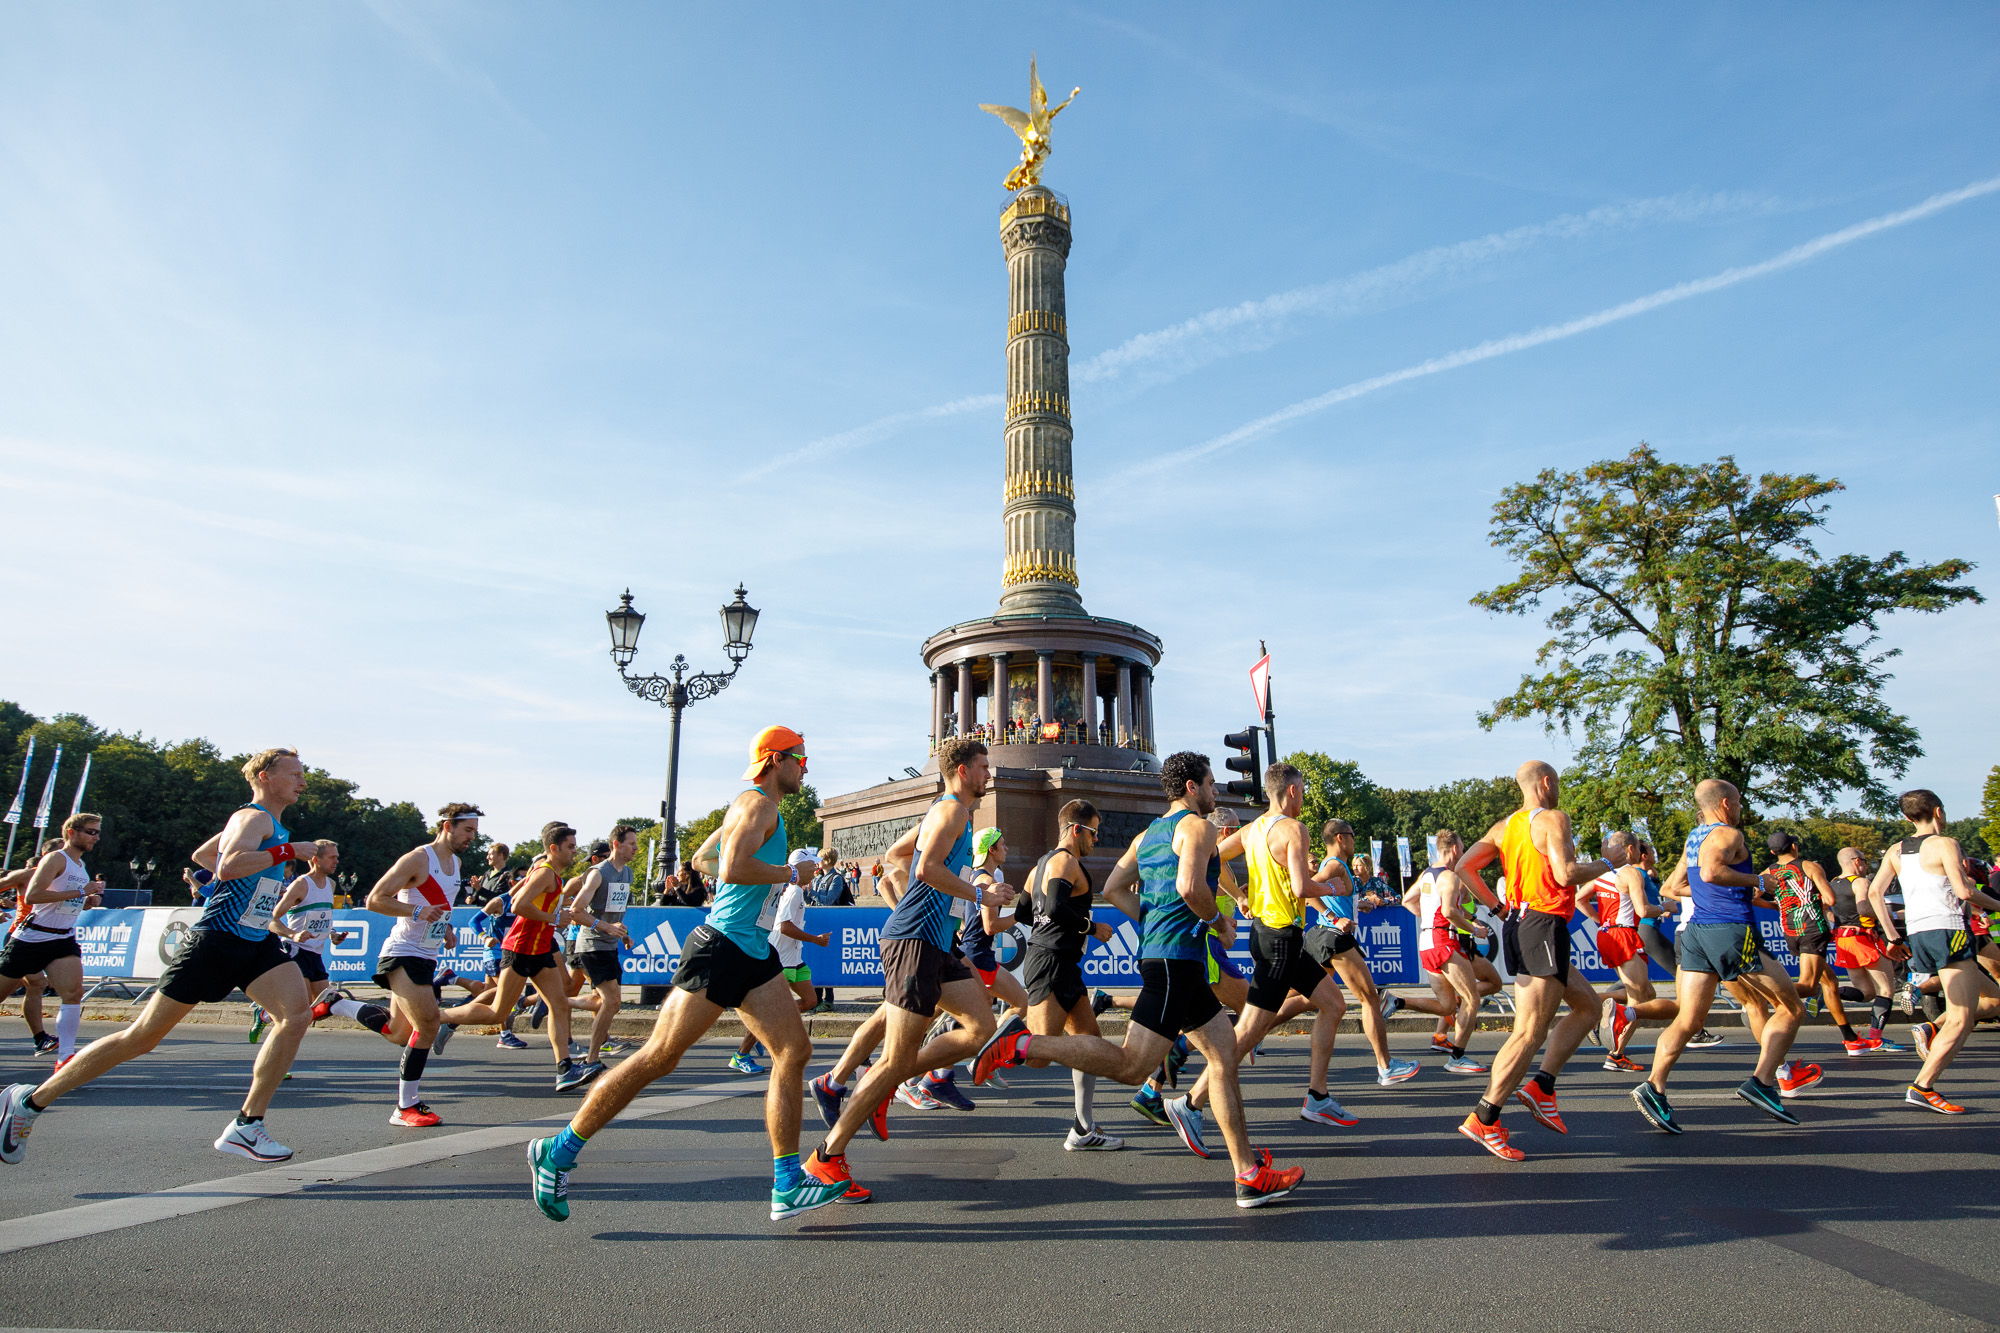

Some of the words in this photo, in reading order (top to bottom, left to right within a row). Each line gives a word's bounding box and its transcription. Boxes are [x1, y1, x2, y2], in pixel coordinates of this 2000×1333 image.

[75, 926, 110, 941] BMW
[79, 943, 108, 954] ERLIN
[1763, 940, 1790, 951] BER
[842, 947, 880, 960] BERL
[82, 955, 125, 967] ARATHON
[328, 960, 366, 971] Abbott
[623, 954, 680, 973] adida
[841, 962, 885, 975] MARA
